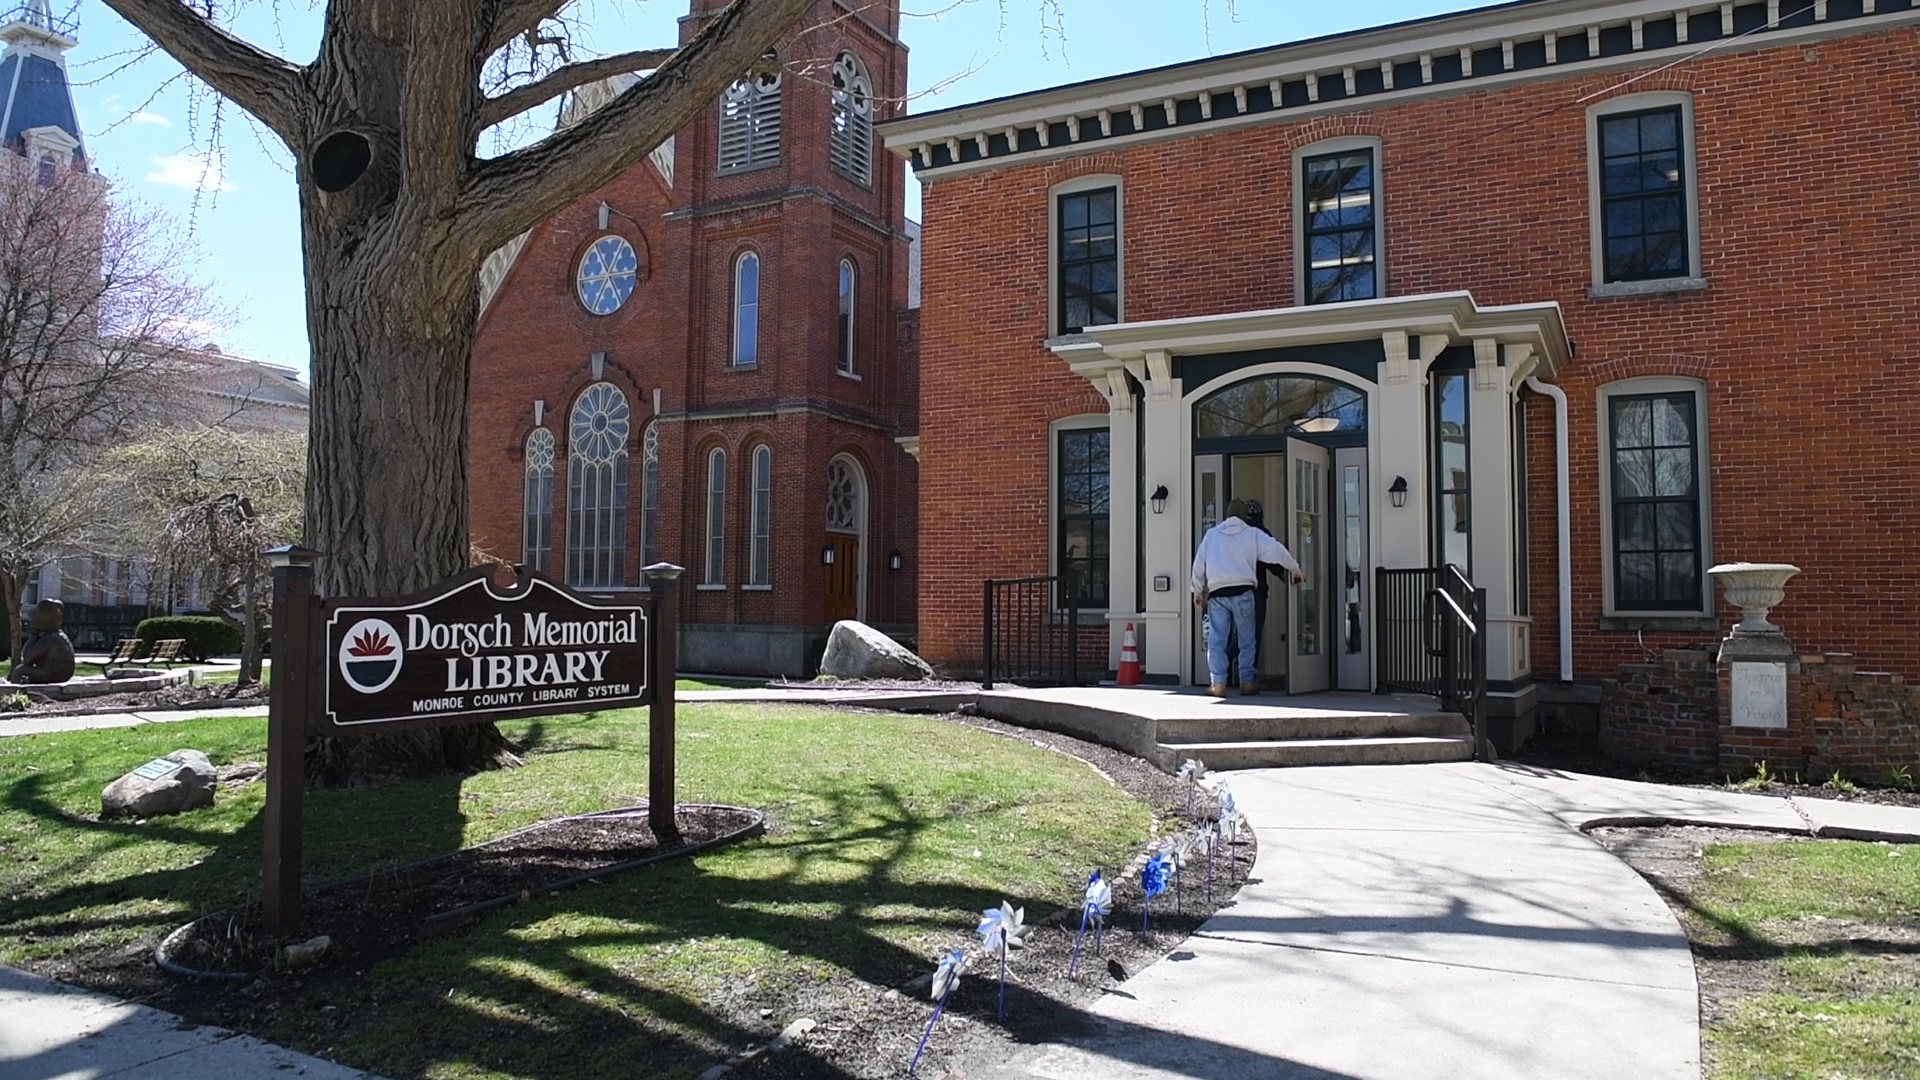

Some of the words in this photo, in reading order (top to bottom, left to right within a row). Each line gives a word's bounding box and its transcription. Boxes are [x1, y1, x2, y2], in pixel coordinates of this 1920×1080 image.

[406, 613, 513, 658] Dorsch
[522, 611, 637, 647] Memorial
[445, 650, 611, 692] LIBRARY
[413, 697, 464, 712] MONROE
[473, 691, 524, 706] COUNTY
[532, 687, 579, 701] LIBRARY
[587, 683, 630, 697] SYSTEM
